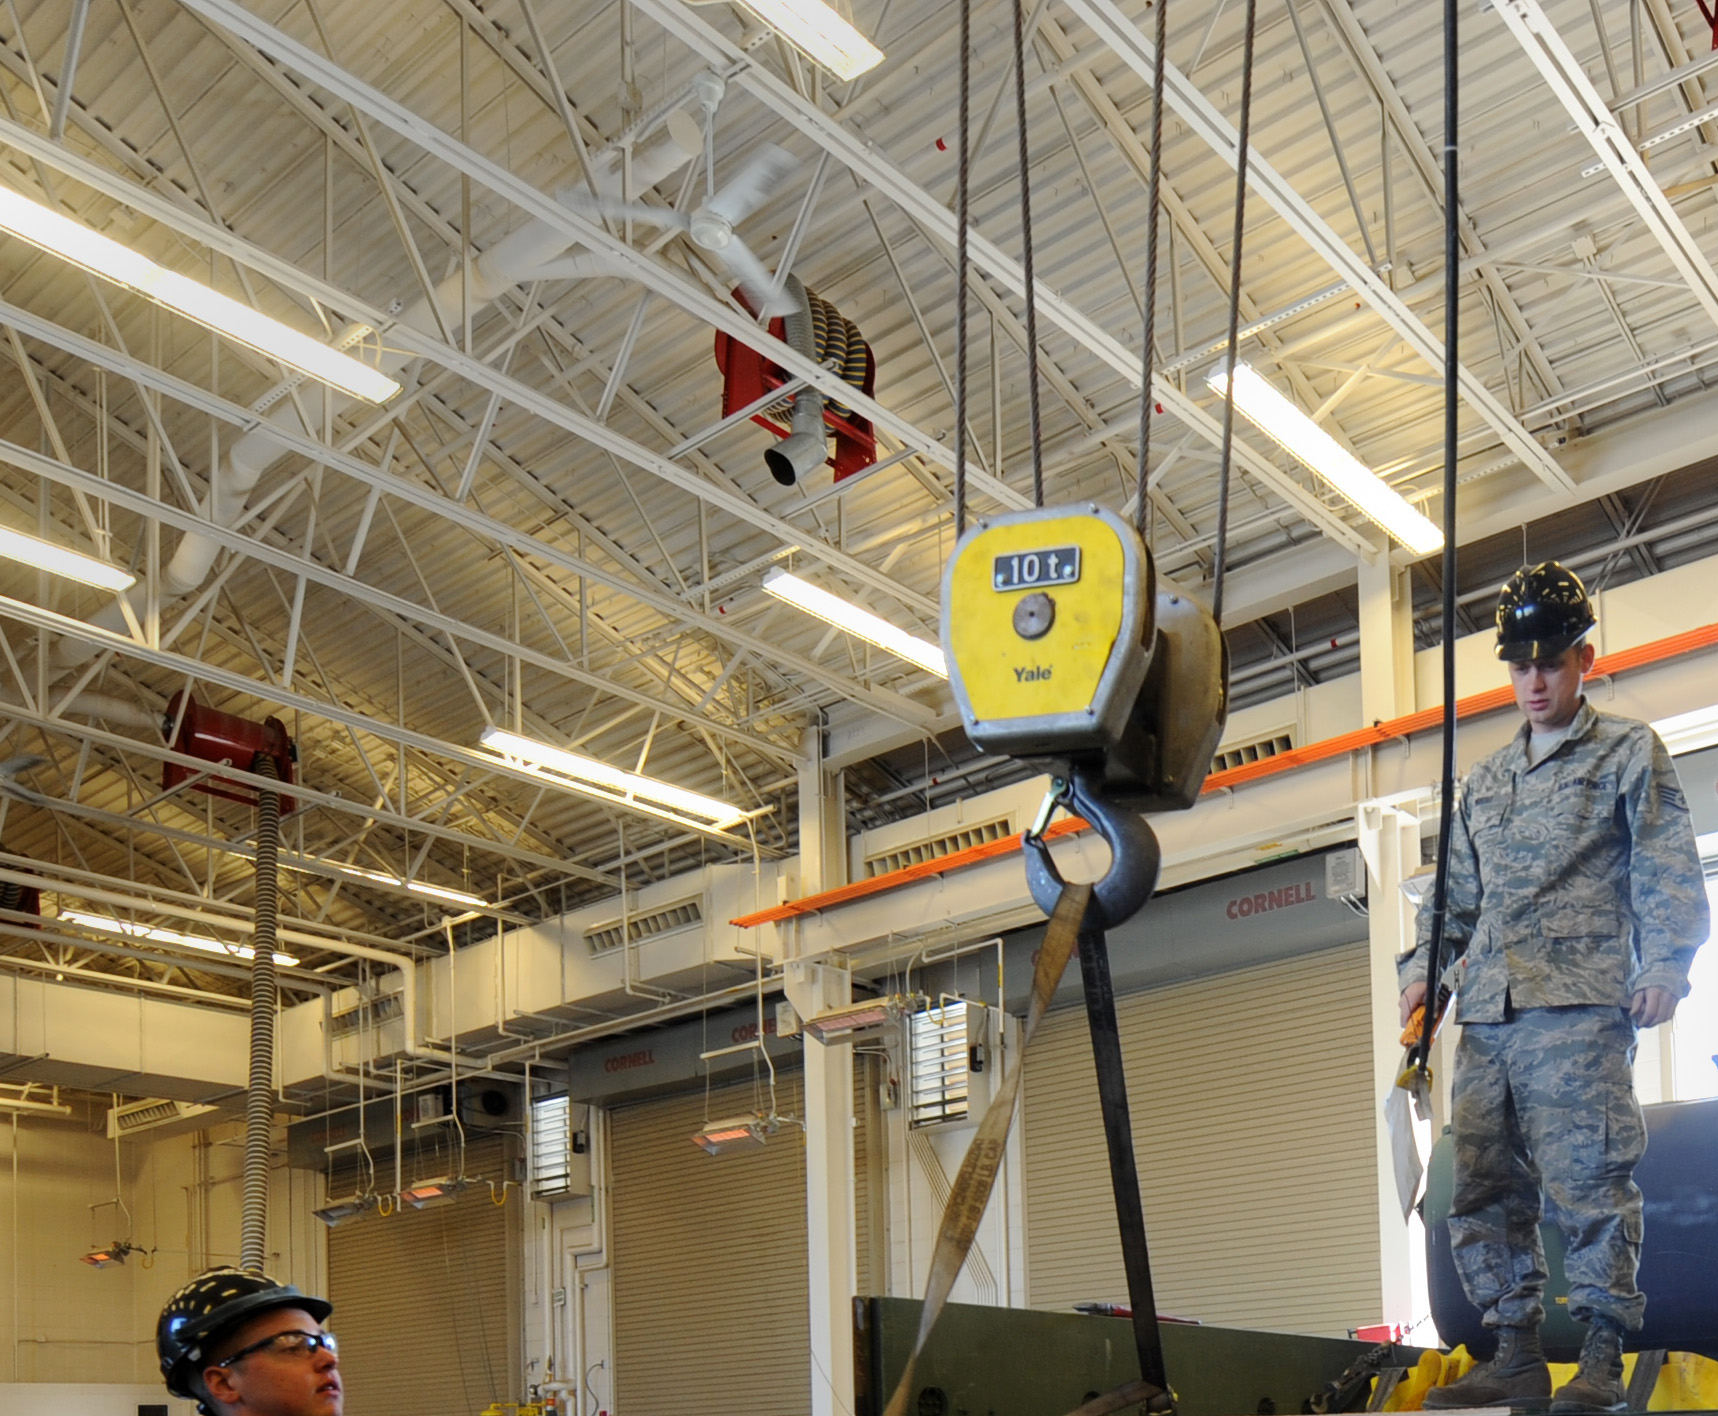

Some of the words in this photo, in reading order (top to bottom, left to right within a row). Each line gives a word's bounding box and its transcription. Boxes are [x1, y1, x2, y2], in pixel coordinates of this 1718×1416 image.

[1011, 554, 1040, 584] 10
[1048, 553, 1059, 579] t
[1014, 666, 1052, 683] Yale
[1226, 882, 1317, 920] CORNELL
[604, 1051, 655, 1073] CORNELL
